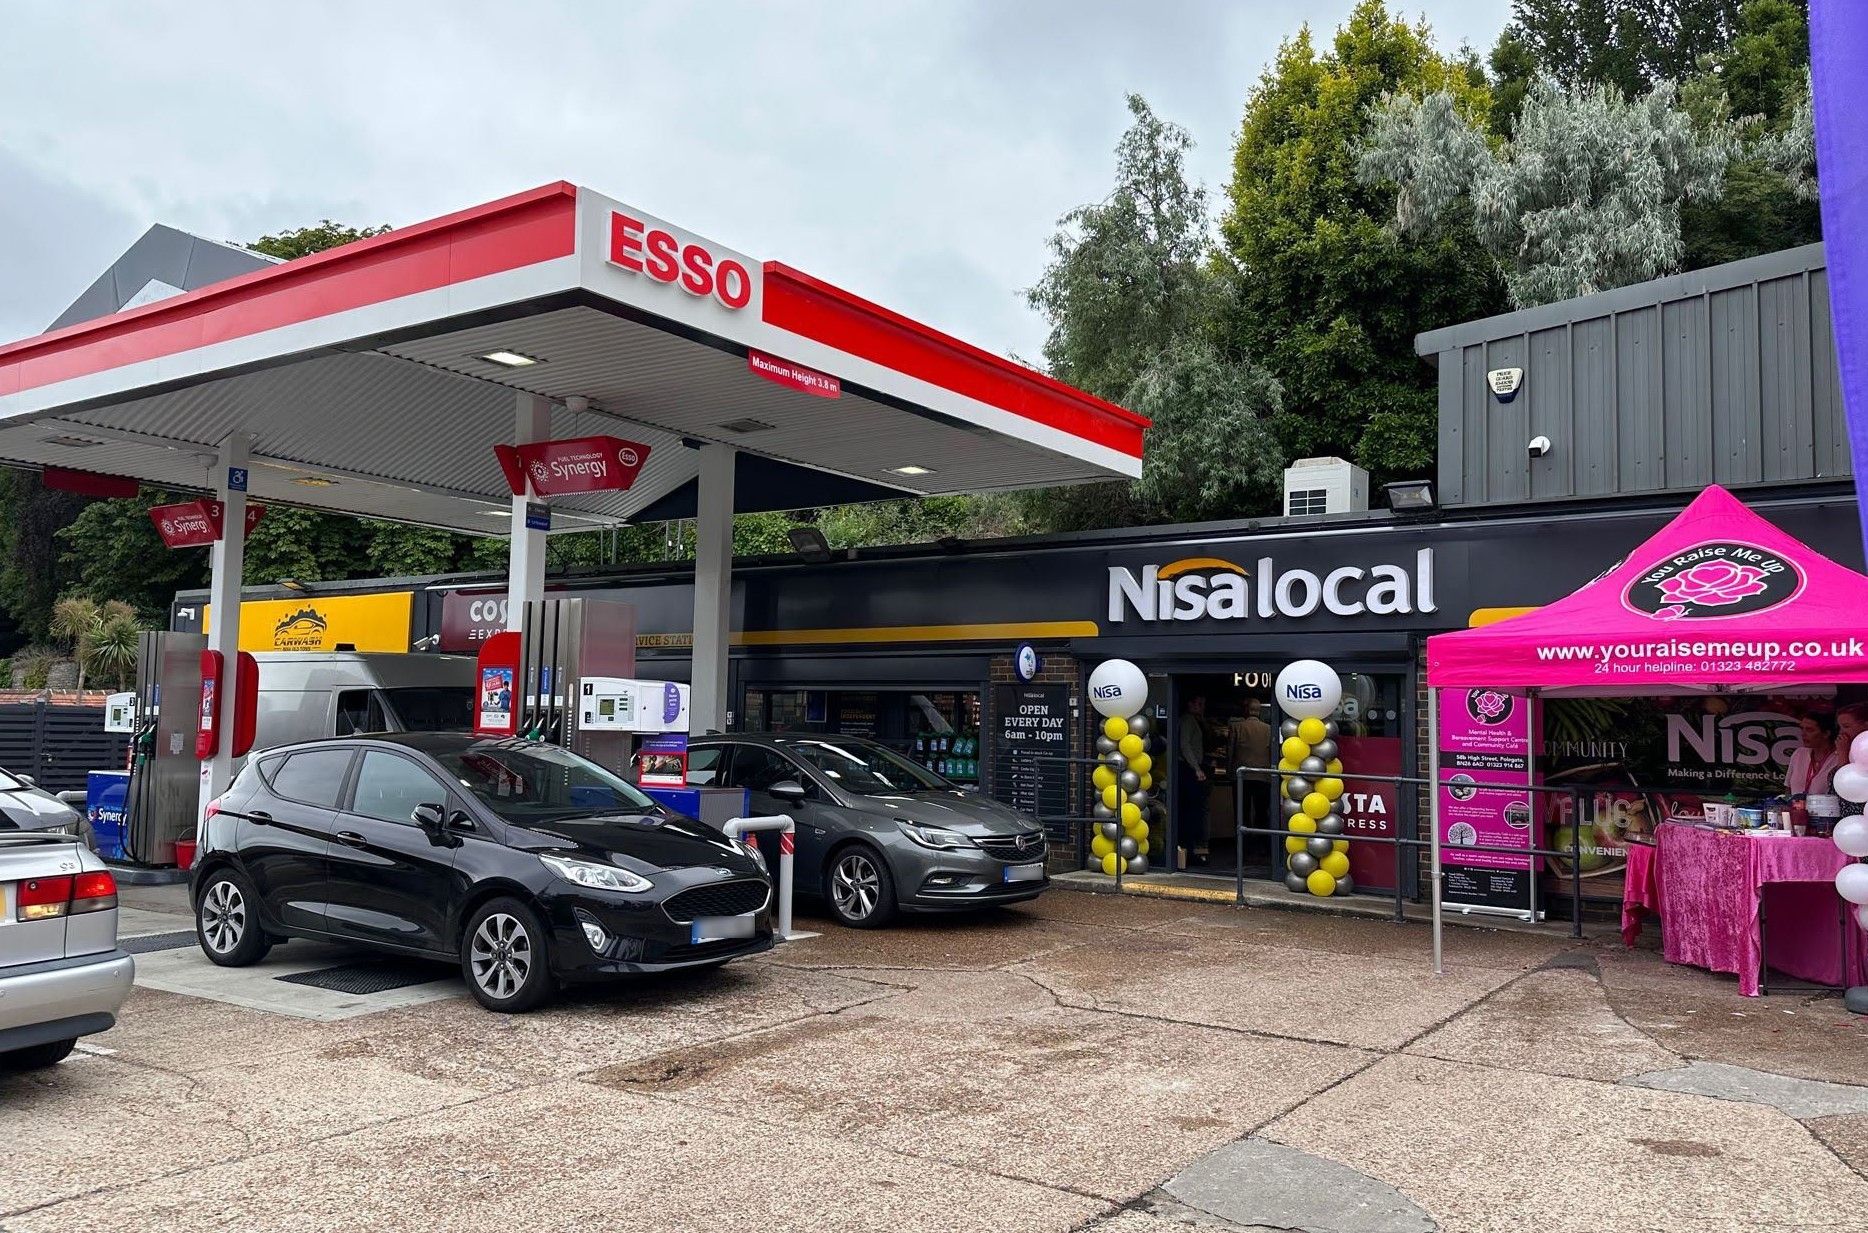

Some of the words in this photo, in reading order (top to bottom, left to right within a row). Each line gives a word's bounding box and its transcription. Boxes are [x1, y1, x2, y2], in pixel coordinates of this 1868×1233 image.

[610, 210, 751, 309] ESSO
[752, 356, 790, 377] Maximum
[791, 370, 816, 387] Height
[818, 378, 829, 390] 3.8
[830, 383, 837, 392] m
[570, 452, 603, 462] TECHNOLOGY
[622, 451, 636, 462] Esso
[551, 460, 607, 480] Synergy
[211, 505, 219, 517] 3
[248, 510, 257, 522] 4
[1641, 566, 1675, 584] You
[1672, 547, 1727, 566] Raise
[1730, 547, 1763, 562] Me
[1760, 559, 1785, 573] Up
[663, 634, 693, 645] STATI
[1536, 638, 1864, 663] www.youraisemeup.co.uk
[1594, 663, 1610, 673] 24
[1613, 662, 1641, 673] hour
[1645, 661, 1697, 674] helpline:
[1700, 661, 1741, 671] 01323
[1745, 660, 1796, 671] 482772
[584, 684, 591, 695] 1
[1094, 685, 1121, 698] Nisa
[1287, 684, 1322, 699] Nisa
[1019, 705, 1049, 715] OPEN
[1005, 717, 1040, 727] EVERY
[1042, 718, 1063, 728] DAY
[1005, 730, 1026, 740] 6am
[1035, 731, 1064, 742] 10pm
[1488, 735, 1510, 743] Support
[1544, 741, 1628, 758] OMMUNITY
[1668, 768, 1705, 780] Making
[1715, 769, 1769, 780] Difference
[1342, 818, 1387, 830] RESS
